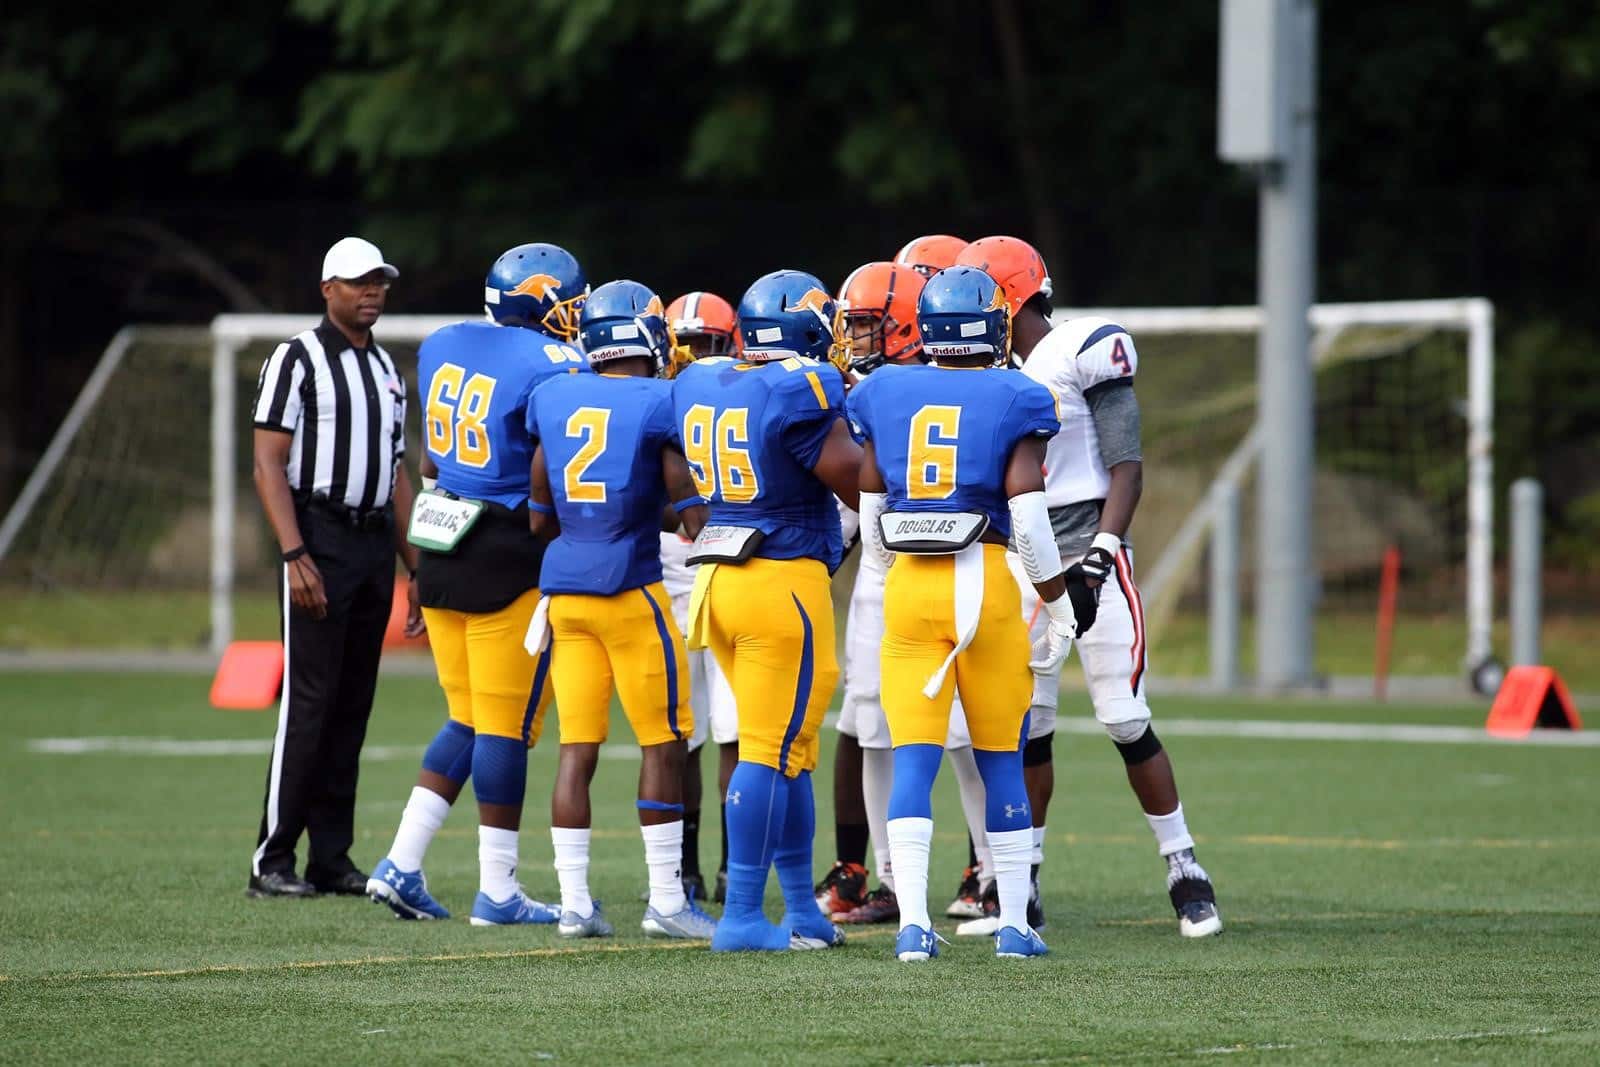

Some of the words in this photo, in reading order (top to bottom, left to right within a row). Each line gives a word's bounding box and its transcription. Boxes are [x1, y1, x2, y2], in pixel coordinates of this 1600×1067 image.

[591, 348, 625, 360] Riddell
[932, 346, 971, 355] Riddell
[1110, 336, 1132, 375] 4
[426, 362, 497, 469] 68
[564, 406, 612, 503] 2
[684, 403, 759, 504] 96
[906, 404, 962, 500] 6
[895, 519, 956, 534] DOUGLAS
